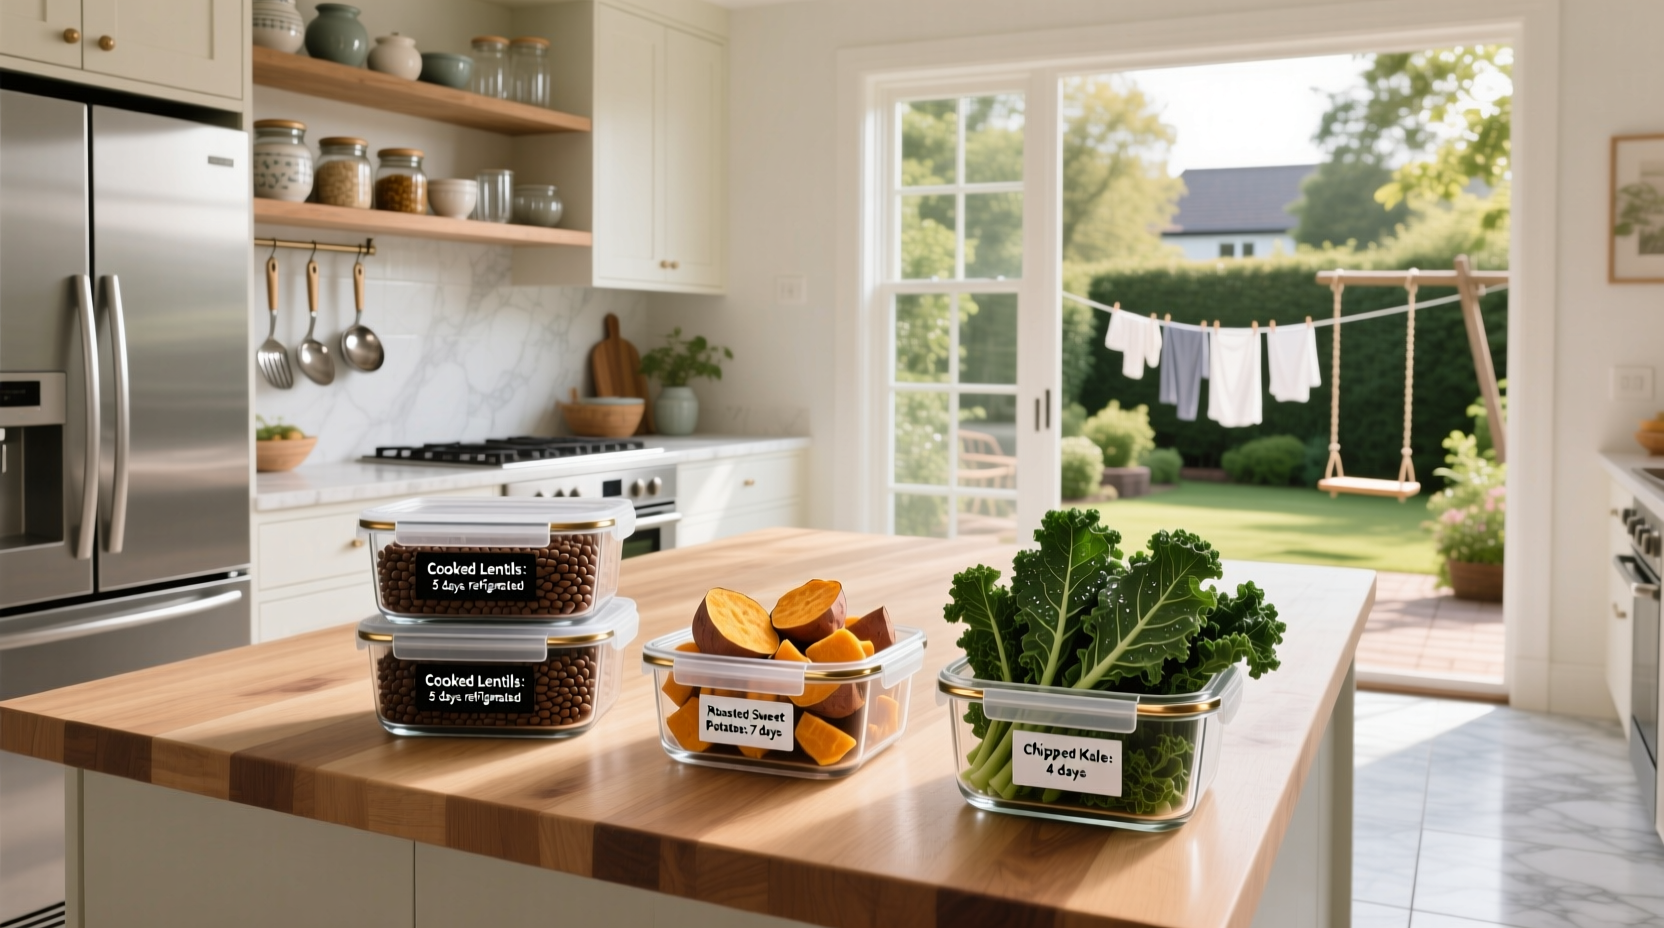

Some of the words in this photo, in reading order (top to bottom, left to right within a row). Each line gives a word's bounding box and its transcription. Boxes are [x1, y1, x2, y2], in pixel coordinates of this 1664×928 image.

[428, 562, 475, 575] Cooked
[432, 579, 438, 590] 5
[426, 674, 474, 687] Cooked
[428, 691, 435, 701] 5
[749, 725, 758, 735] 7
[1024, 742, 1076, 761] Chipped
[1080, 748, 1112, 763] Kale:
[1045, 763, 1054, 774] 4
